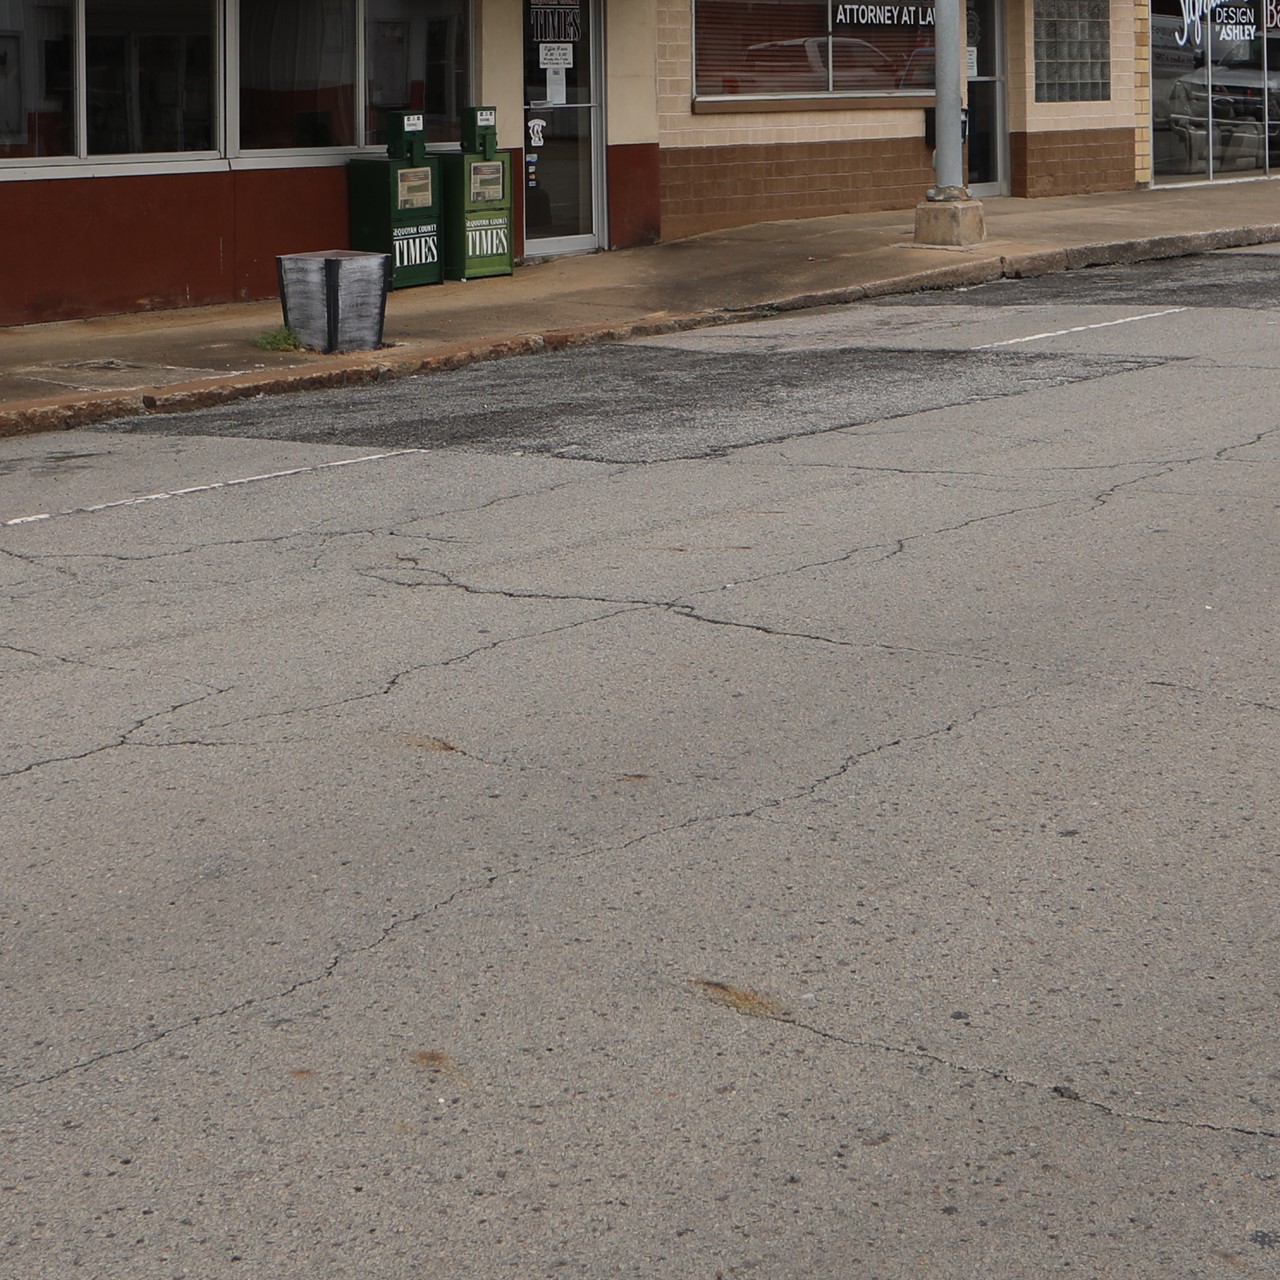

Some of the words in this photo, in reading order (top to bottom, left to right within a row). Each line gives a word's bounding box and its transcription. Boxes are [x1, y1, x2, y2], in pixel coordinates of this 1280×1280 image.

[530, 8, 581, 42] TIMES
[836, 4, 900, 25] ATTORNEY
[901, 6, 916, 25] AT
[918, 6, 936, 25] LA
[1215, 7, 1255, 24] DESIGN
[1219, 24, 1257, 41] ASHLEY
[418, 224, 437, 232] COUNTY
[393, 237, 438, 267] TIMES
[466, 228, 508, 256] TIMES
